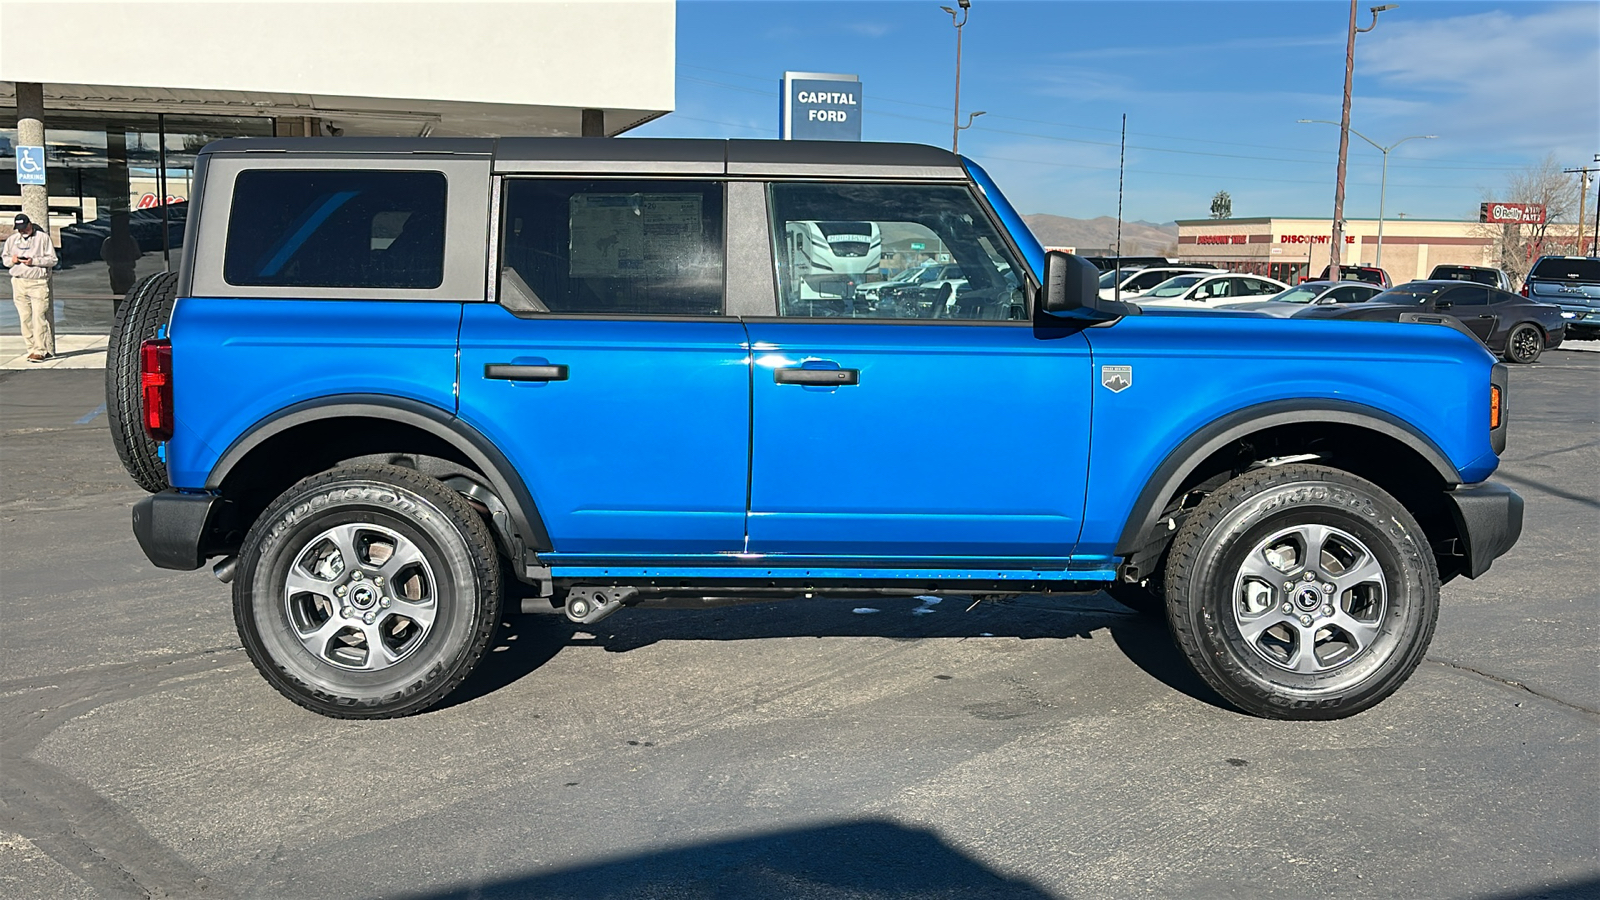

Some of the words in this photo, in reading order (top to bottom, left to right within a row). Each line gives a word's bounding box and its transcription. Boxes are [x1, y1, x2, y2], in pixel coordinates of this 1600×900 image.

[798, 91, 857, 105] CAPITAL
[808, 109, 847, 122] FORD
[1281, 235, 1331, 244] DISCOUNT
